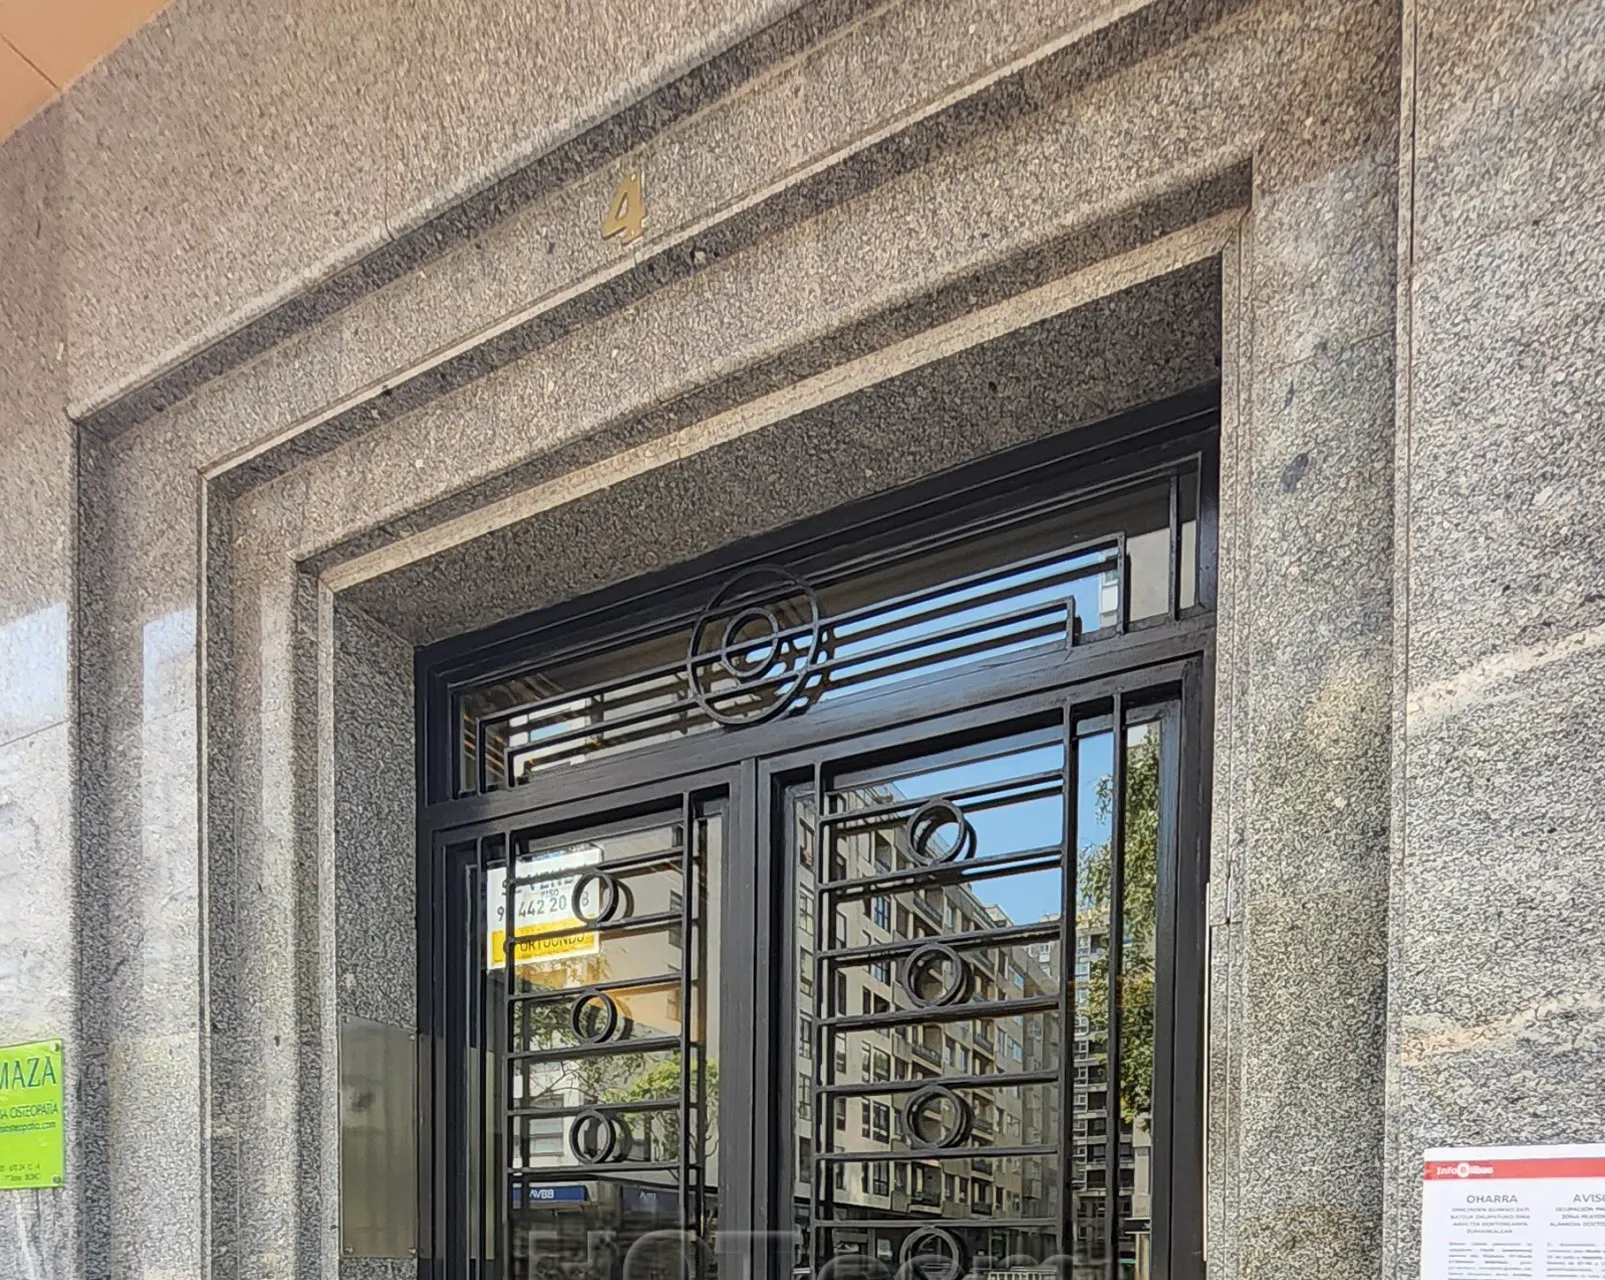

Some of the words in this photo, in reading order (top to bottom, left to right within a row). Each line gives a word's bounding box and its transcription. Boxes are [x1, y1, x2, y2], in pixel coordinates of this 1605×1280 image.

[601, 173, 647, 246] 4
[518, 900, 545, 918] 442
[550, 894, 567, 912] 20
[1466, 1194, 1518, 1204] OHARRA
